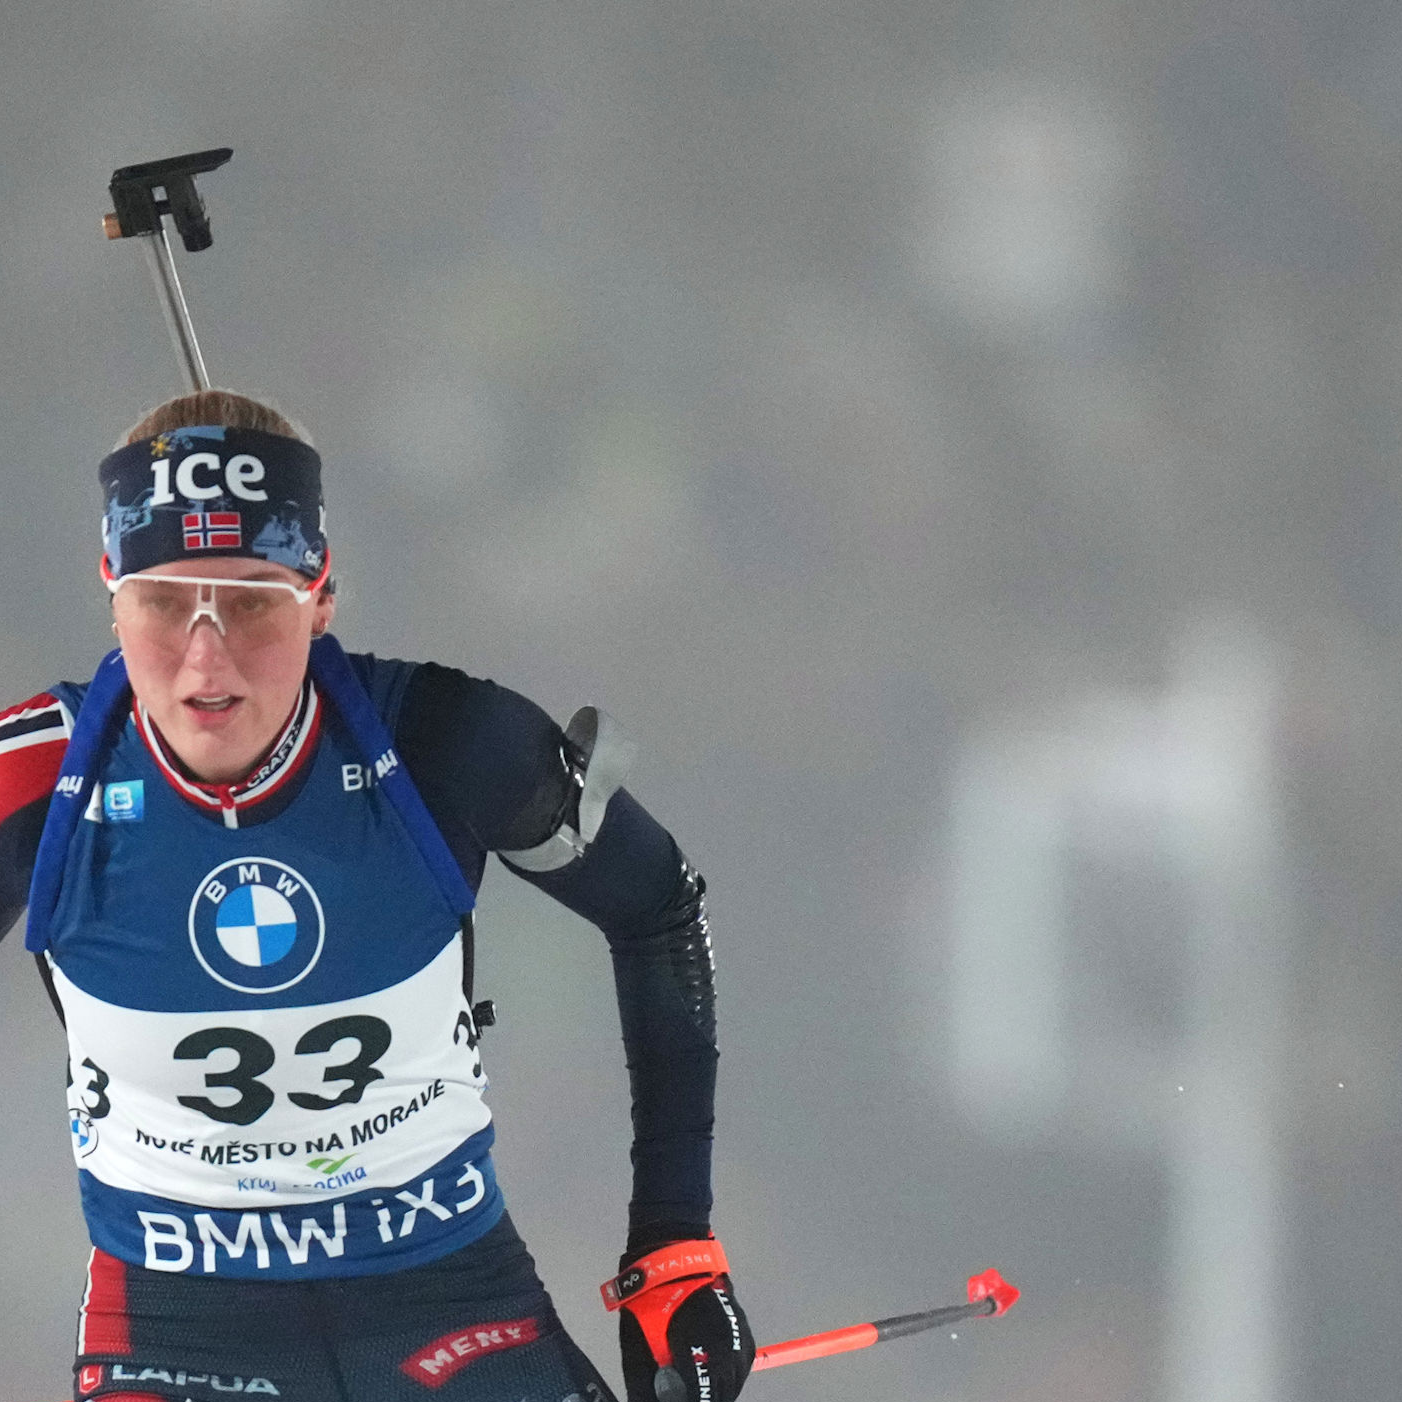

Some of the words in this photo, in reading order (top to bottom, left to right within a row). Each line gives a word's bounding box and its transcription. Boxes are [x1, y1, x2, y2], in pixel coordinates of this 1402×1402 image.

[150, 452, 269, 507] ice
[203, 864, 301, 905] BMW
[173, 1014, 393, 1126] 33
[200, 1140, 297, 1166] MĚSTO
[306, 1132, 344, 1154] NA
[137, 1203, 347, 1273] BMW
[418, 1326, 522, 1376] MENY
